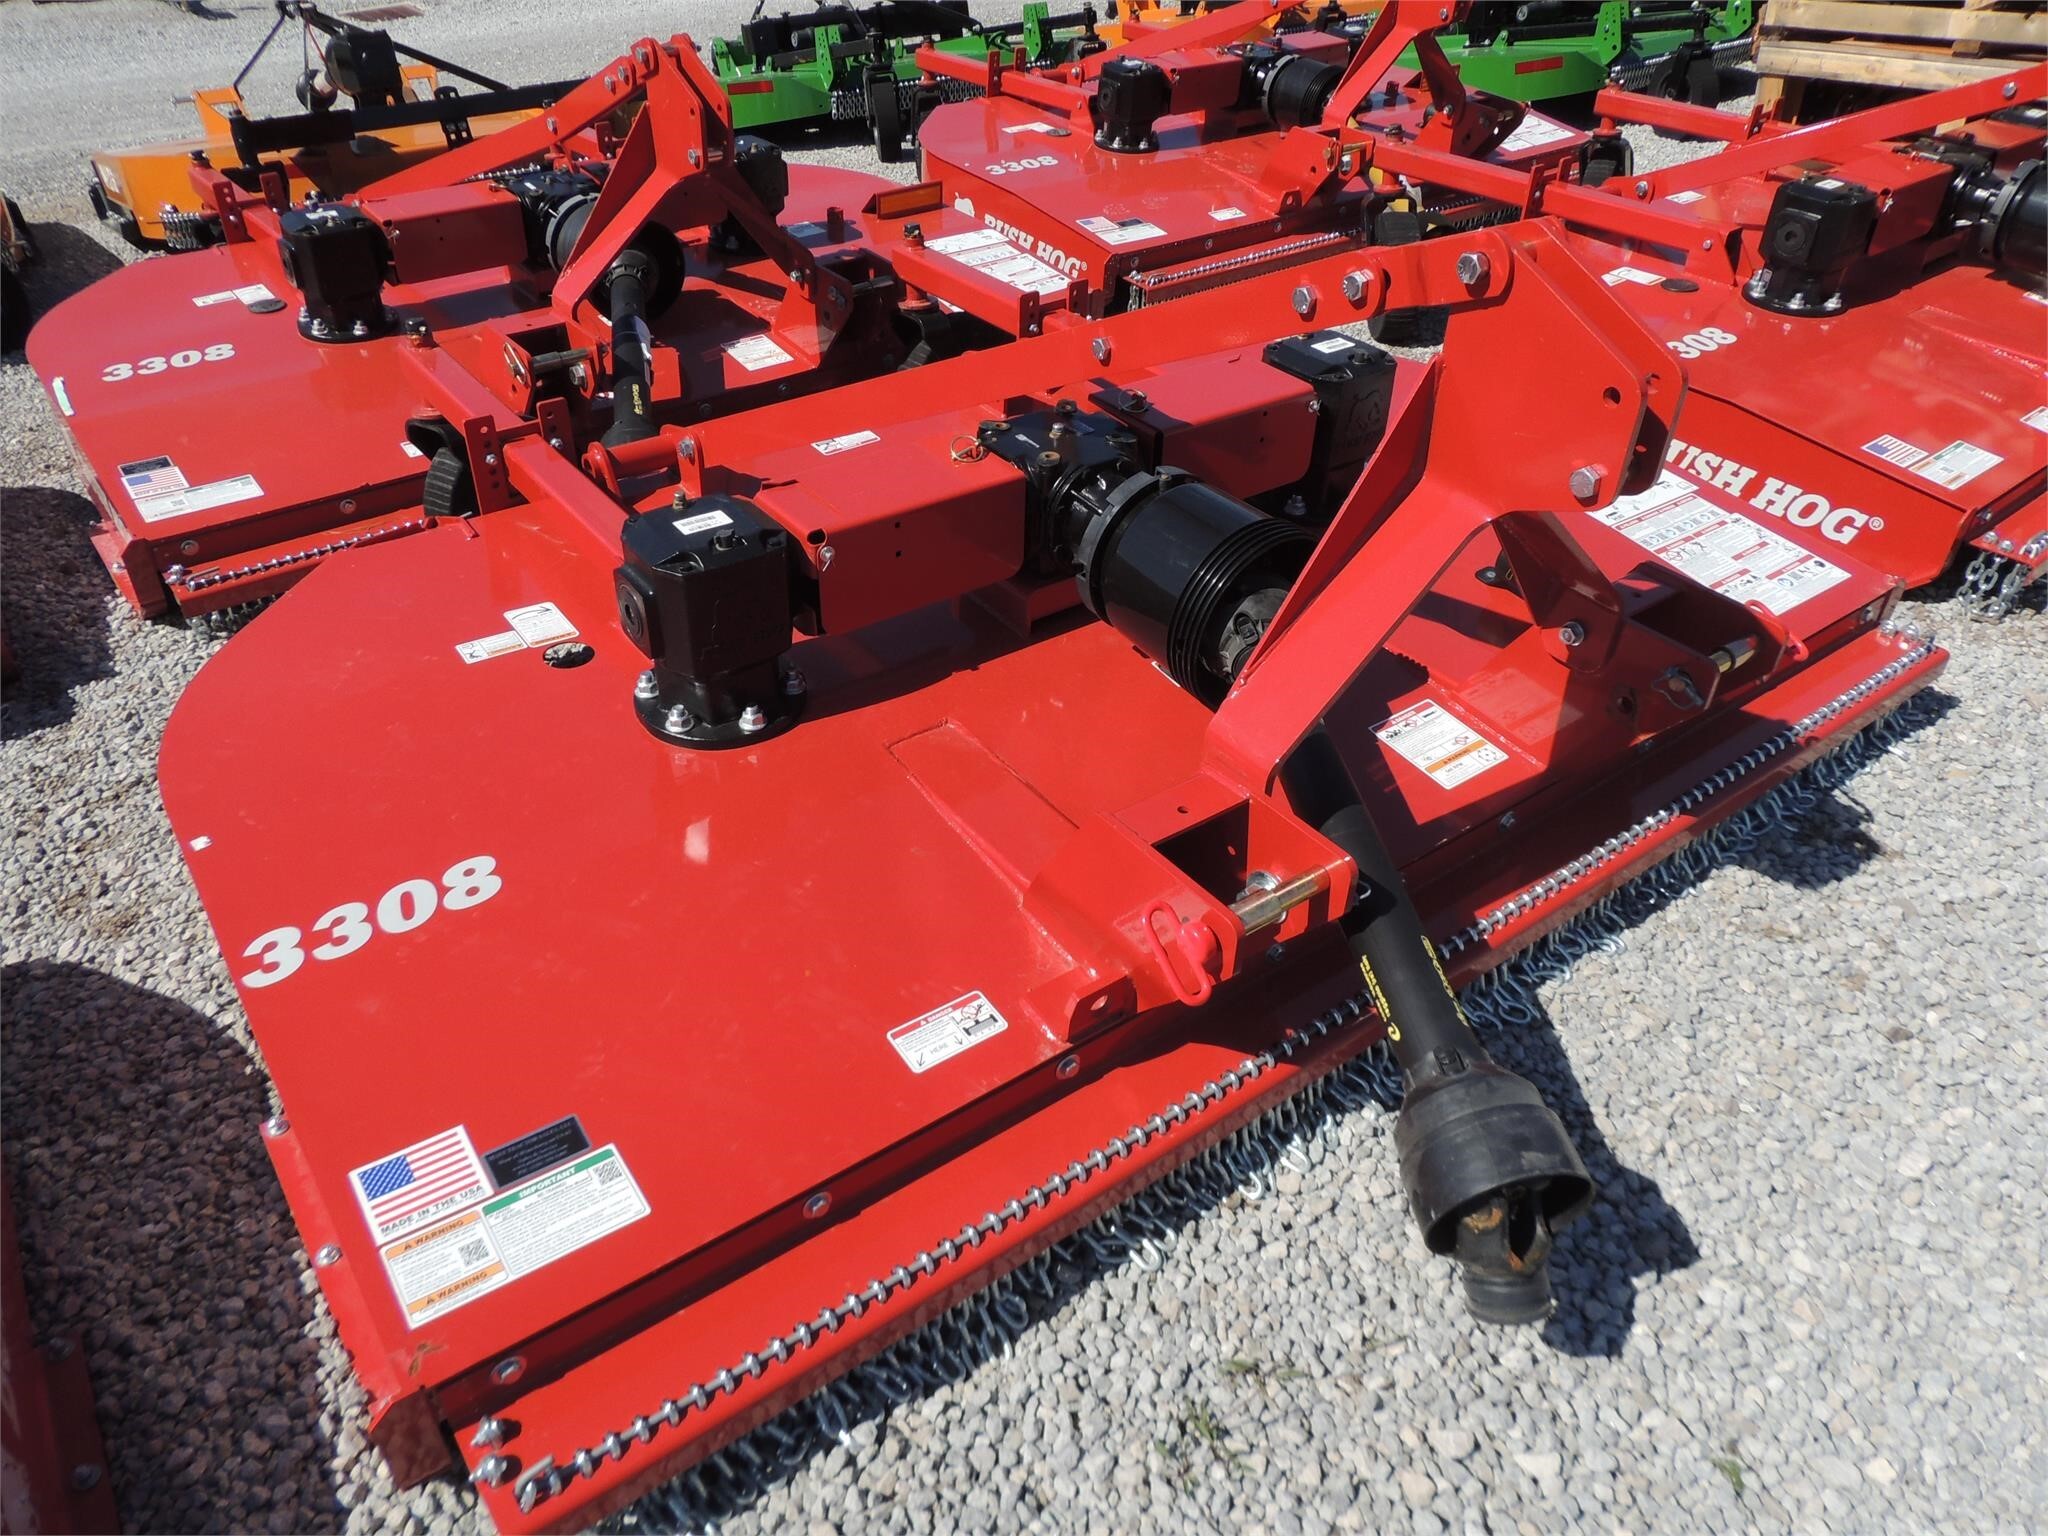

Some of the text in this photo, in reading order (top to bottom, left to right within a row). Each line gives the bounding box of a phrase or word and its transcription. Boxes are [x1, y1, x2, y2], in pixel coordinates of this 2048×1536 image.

[985, 156, 1058, 175] 3308
[1666, 327, 1737, 359] 308
[102, 343, 236, 382] 3308
[1664, 439, 1758, 498] USH
[240, 855, 503, 988] 3308
[518, 1166, 576, 1198] IMPORTANT
[380, 1184, 483, 1234] MADE IN THE USA
[415, 1220, 465, 1245] WARNING
[438, 1271, 488, 1299] WARNING
